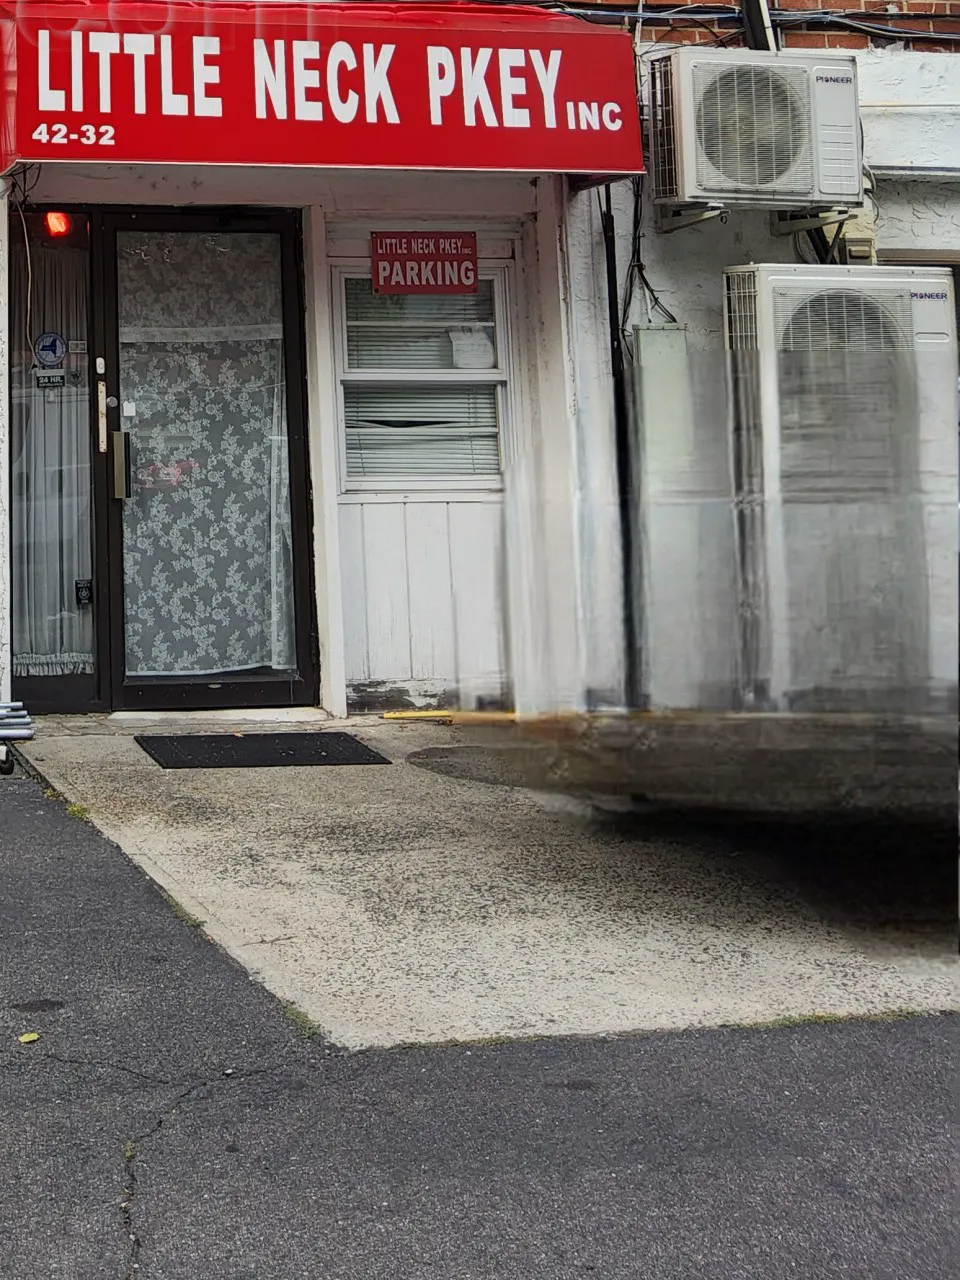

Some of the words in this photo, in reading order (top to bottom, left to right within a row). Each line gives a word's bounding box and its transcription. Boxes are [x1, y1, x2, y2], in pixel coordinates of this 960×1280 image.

[38, 30, 223, 118] LITTLE
[253, 38, 401, 124] NECK
[426, 45, 563, 129] PKEY
[566, 100, 624, 131] INC
[815, 75, 852, 84] PIONEER
[31, 123, 116, 146] 42-32
[377, 238, 408, 254] LITTLE
[411, 238, 436, 254] NECK
[439, 238, 462, 254] PKEY
[378, 261, 475, 286] PARKING
[910, 292, 947, 300] PIONEER
